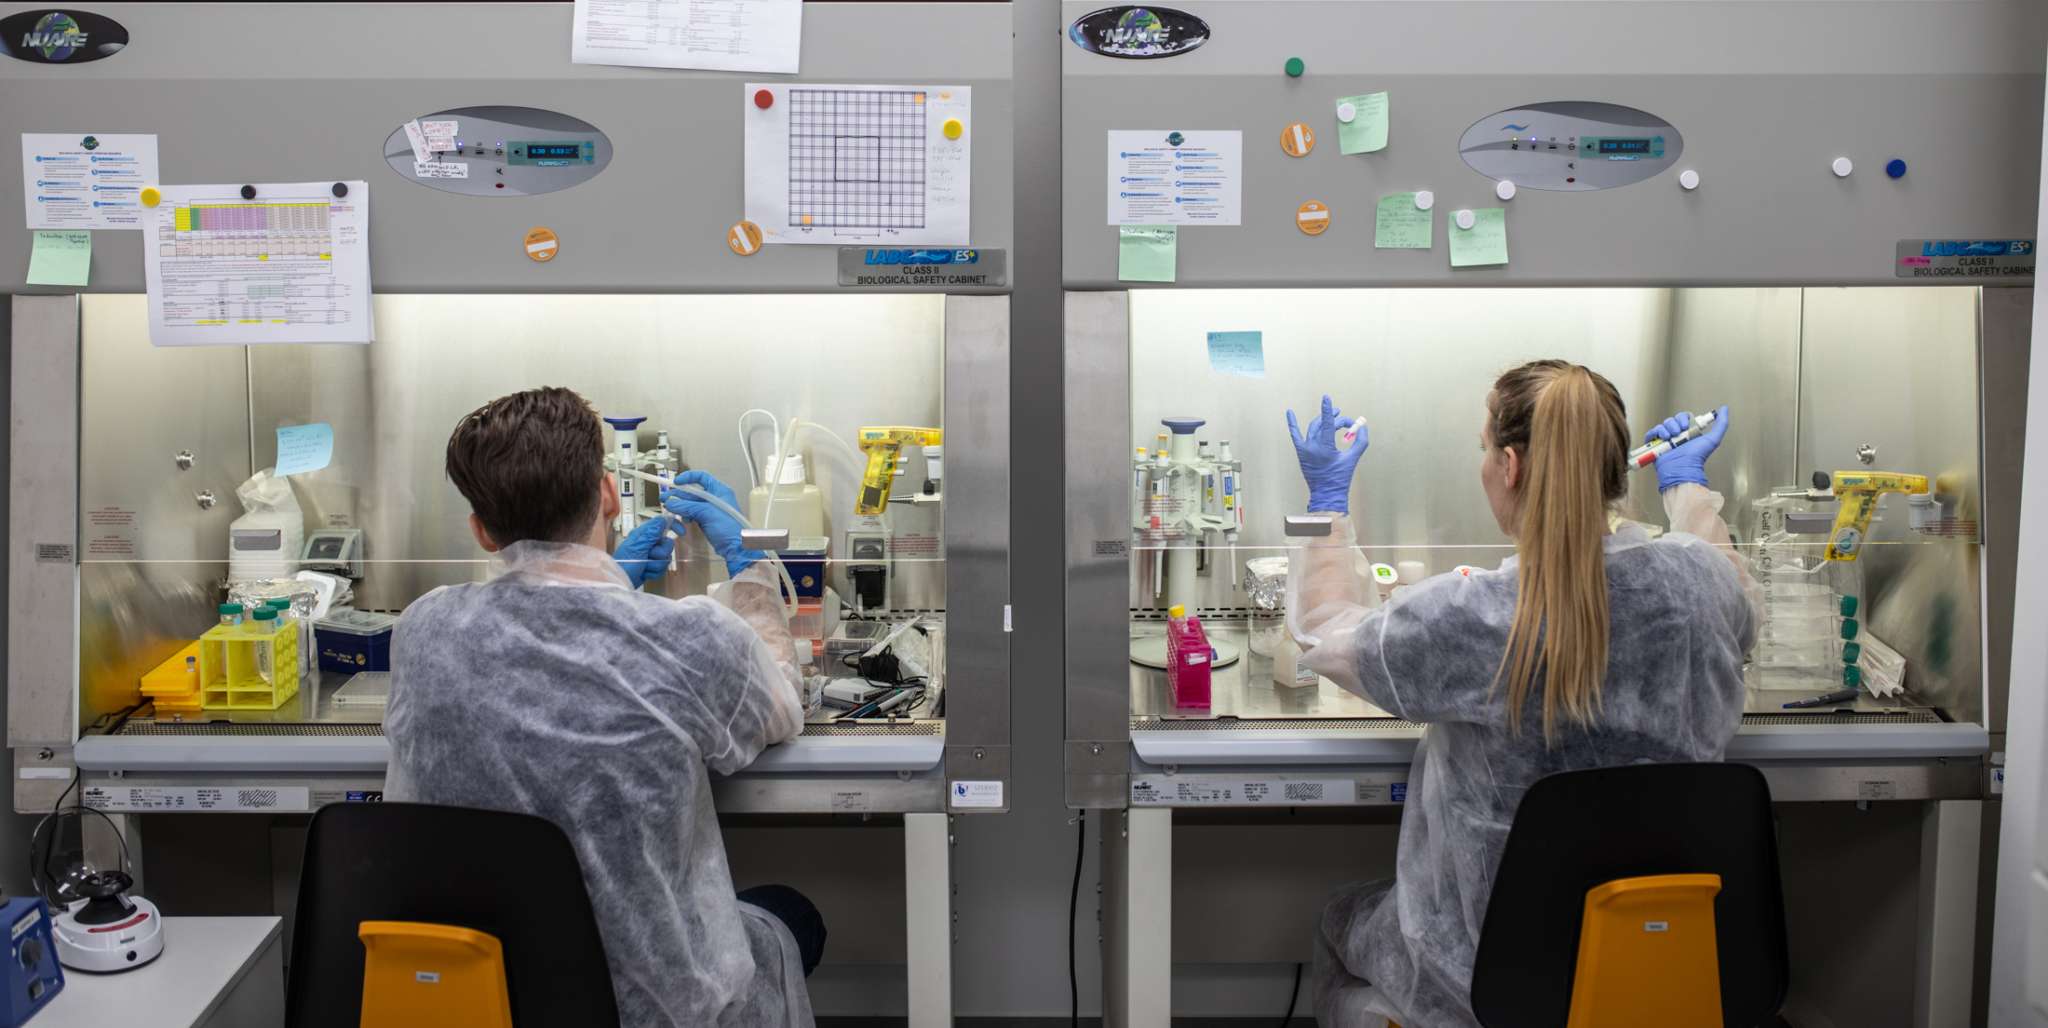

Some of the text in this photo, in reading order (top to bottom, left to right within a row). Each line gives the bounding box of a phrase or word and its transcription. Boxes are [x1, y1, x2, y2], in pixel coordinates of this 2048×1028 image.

[1958, 258, 1987, 266] CLASS
[903, 266, 931, 275] CLASS
[1914, 265, 2036, 277] BIOLOGICAL SAFETY CABINE
[857, 275, 987, 285] BIOLOGICAL SAFETY CABINET
